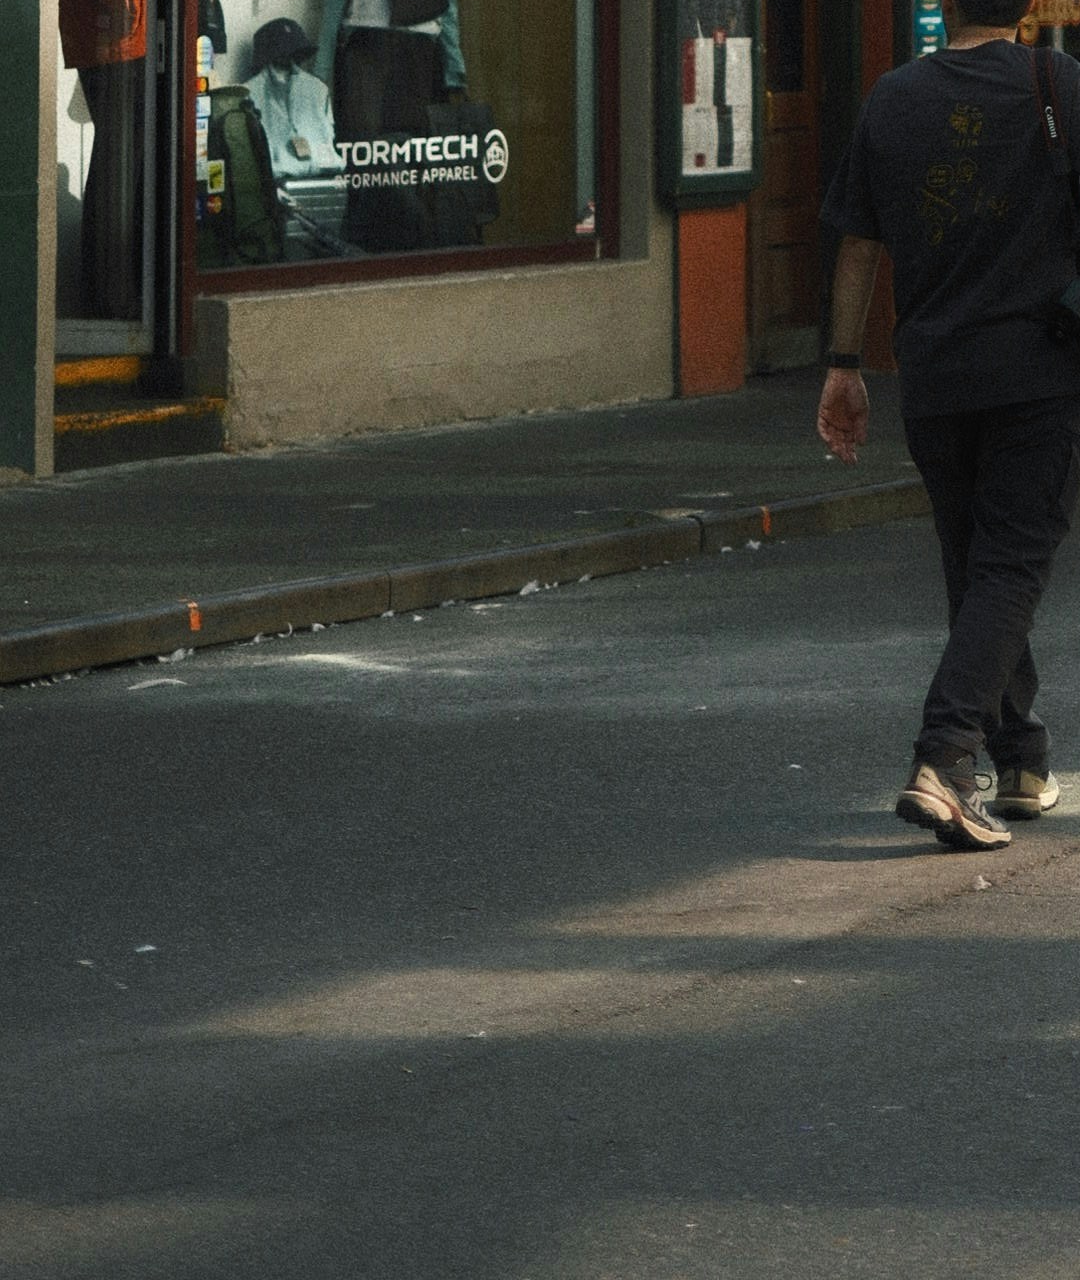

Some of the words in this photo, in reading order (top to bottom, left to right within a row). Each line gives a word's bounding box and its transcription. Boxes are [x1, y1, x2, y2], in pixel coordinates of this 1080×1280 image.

[1045, 106, 1057, 138] Canon
[335, 134, 478, 167] TORMTECH
[422, 166, 478, 183] APPAREL
